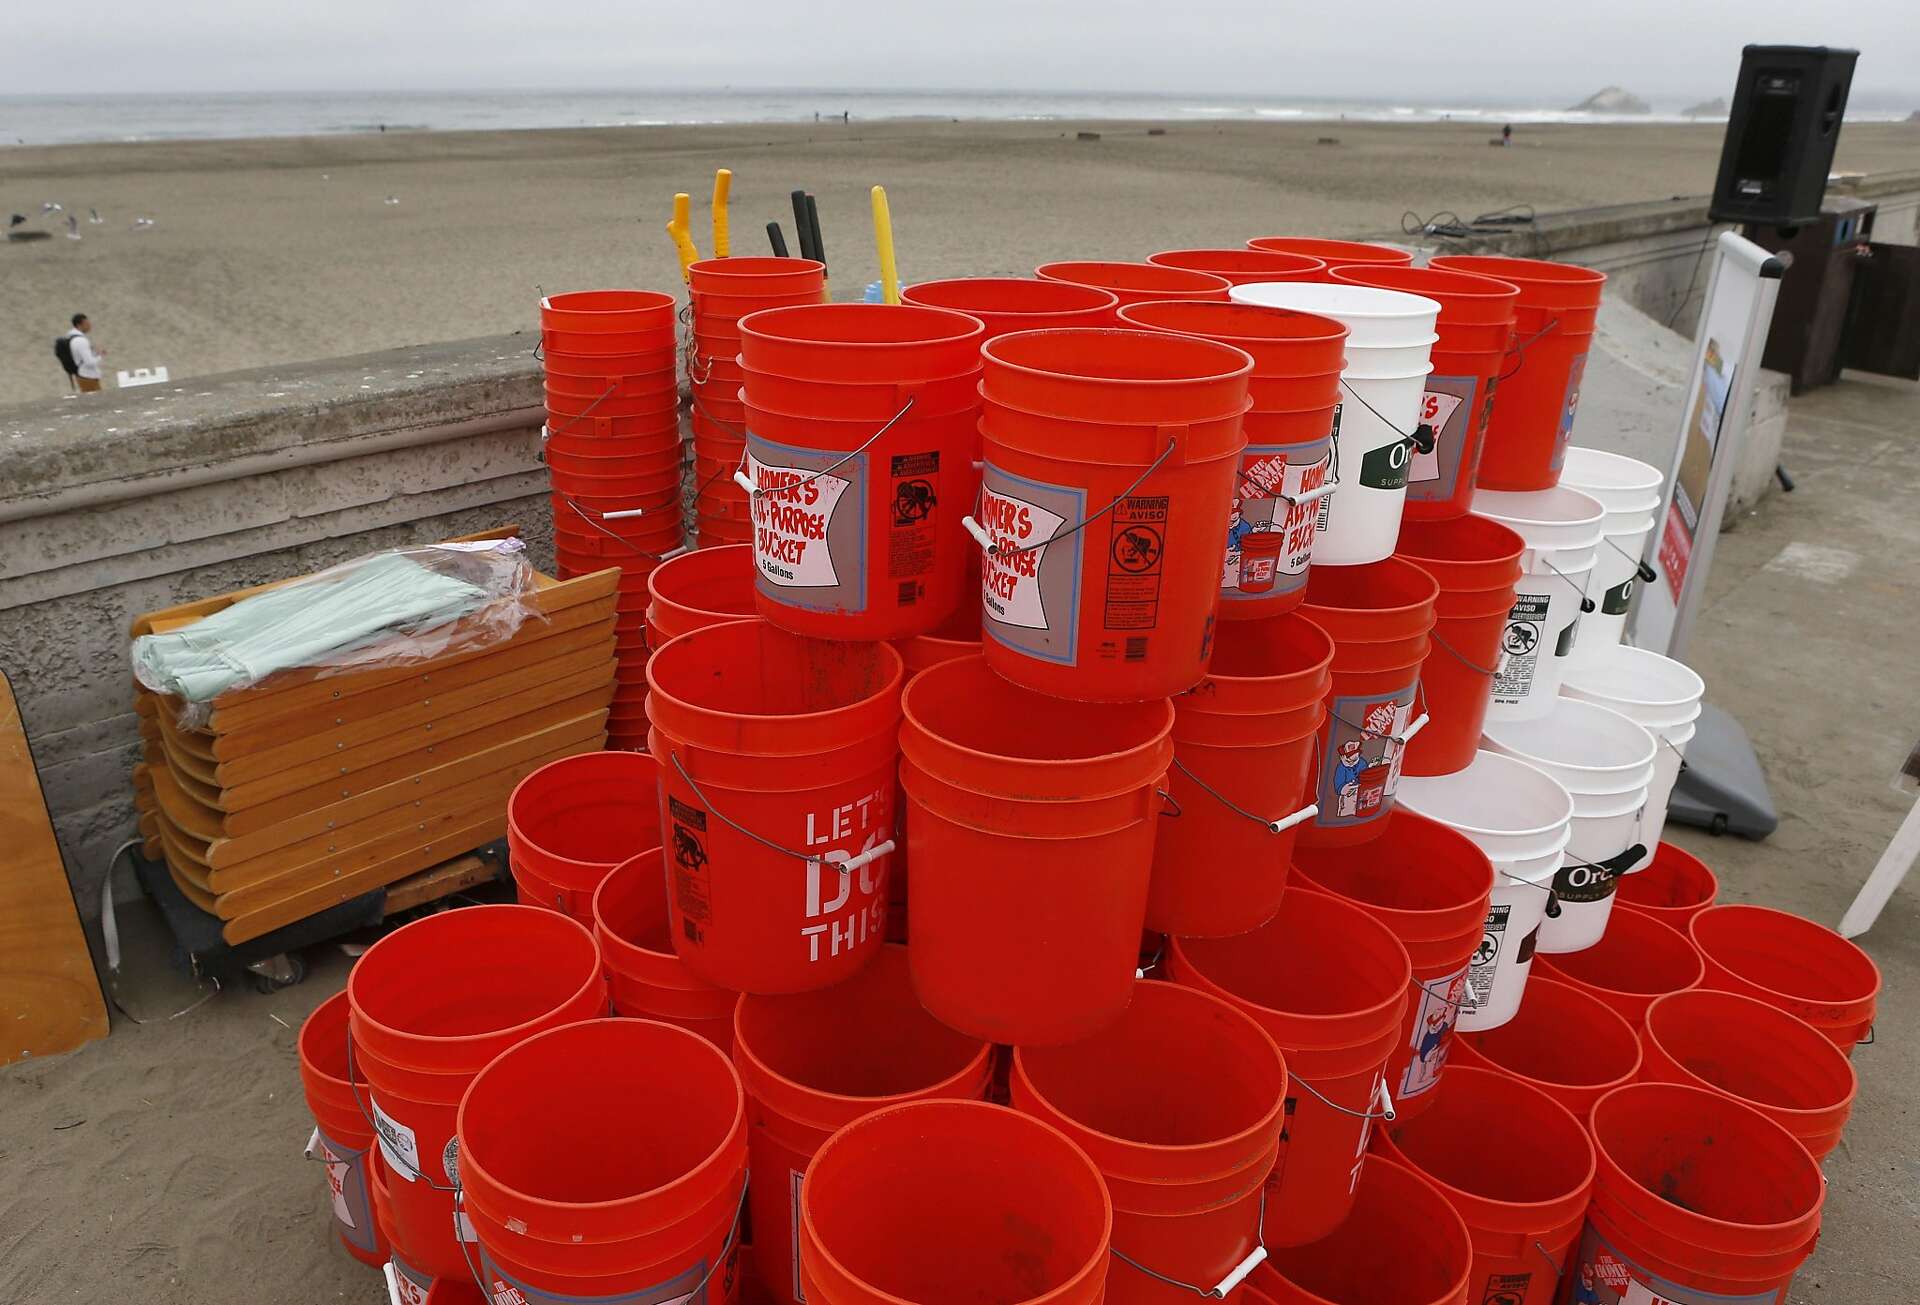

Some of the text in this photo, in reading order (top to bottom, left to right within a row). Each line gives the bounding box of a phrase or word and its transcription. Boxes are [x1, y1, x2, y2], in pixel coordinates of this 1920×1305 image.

[1240, 456, 1285, 499] HOME
[1245, 459, 1265, 478] THE
[756, 465, 820, 505] HOMER'S
[1127, 498, 1168, 510] WARNING
[1129, 511, 1164, 520] AVISO
[757, 527, 807, 565] BUCKET
[762, 558, 794, 580] 5 Gallons
[1290, 558, 1296, 568] 5
[1488, 906, 1509, 914] NING
